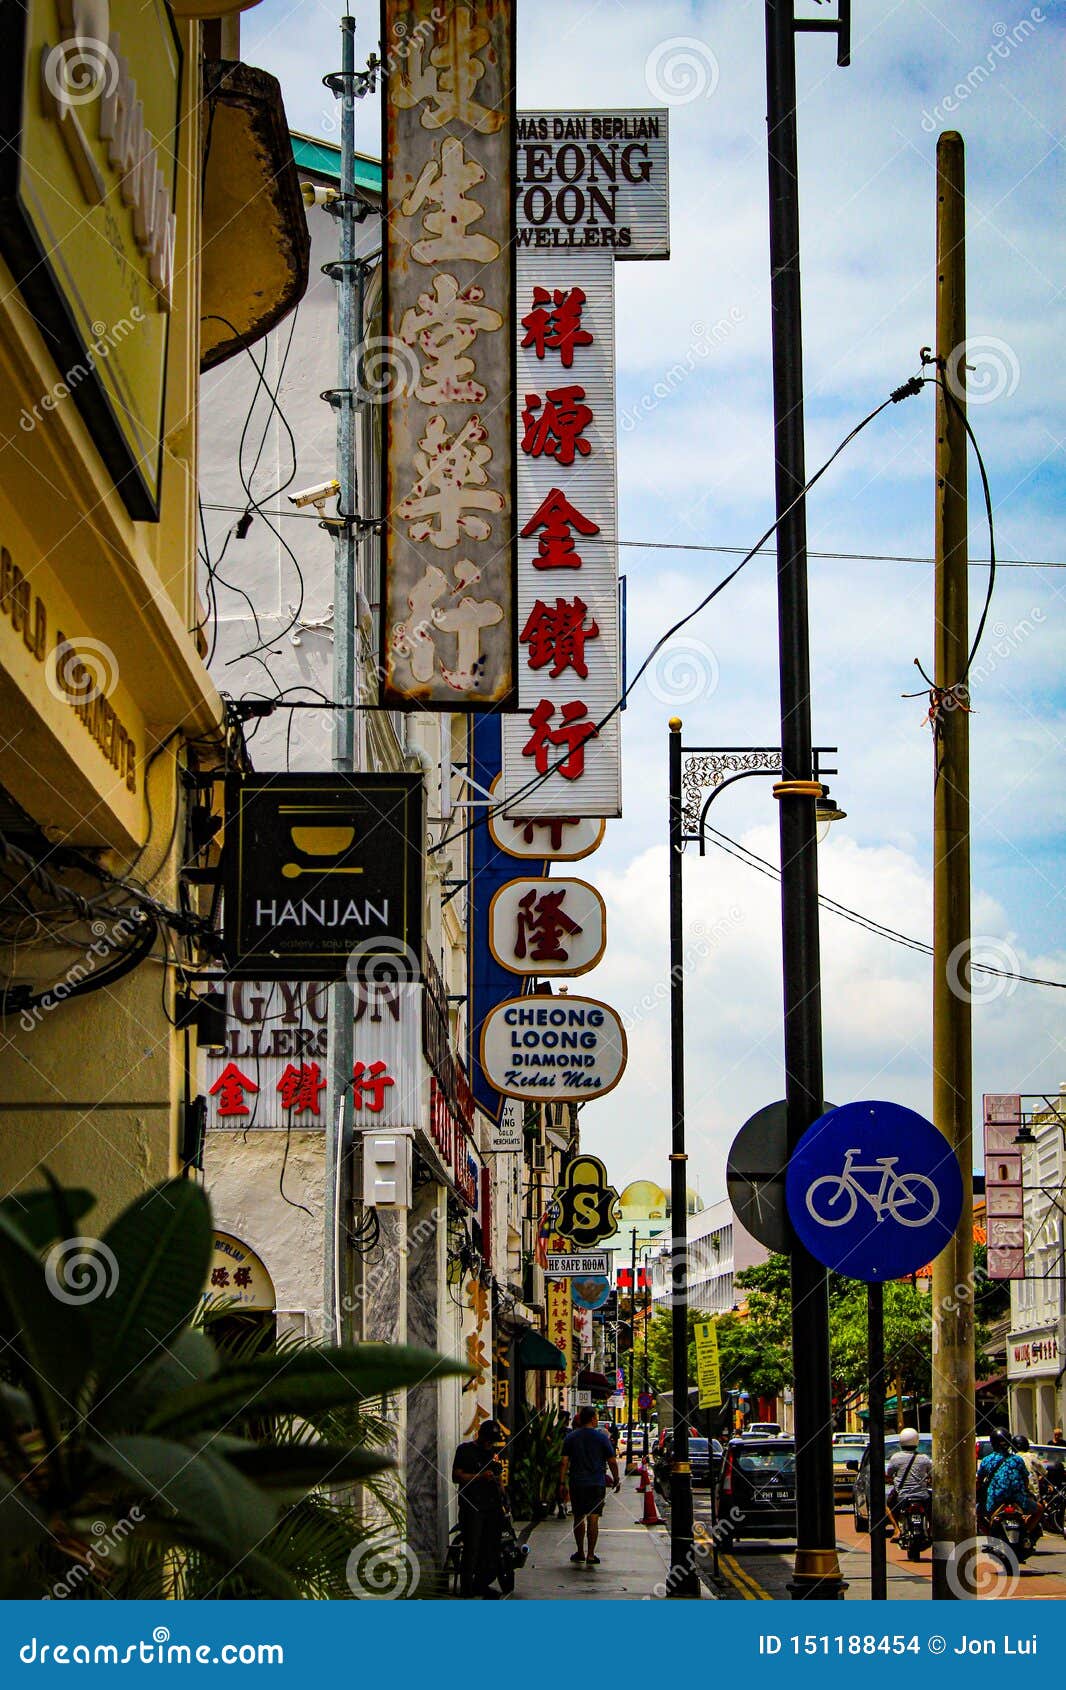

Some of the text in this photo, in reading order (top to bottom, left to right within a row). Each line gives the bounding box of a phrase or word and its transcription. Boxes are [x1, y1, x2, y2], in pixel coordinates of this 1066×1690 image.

[553, 118, 587, 140] DAN
[591, 117, 659, 139] BERLIAN
[516, 227, 632, 247] WELLERS
[520, 286, 600, 780] 祥源金鑽行
[256, 899, 389, 926] HANJAN
[279, 981, 400, 1023] YON
[504, 1008, 605, 1027] CHEONG
[511, 1031, 598, 1049] LOONG
[512, 1054, 596, 1068] DIAMOND
[209, 1060, 395, 1116] 金鑽行
[504, 1070, 602, 1088] Kedai Mas
[548, 1258, 605, 1271] HE SAFE ROOM
